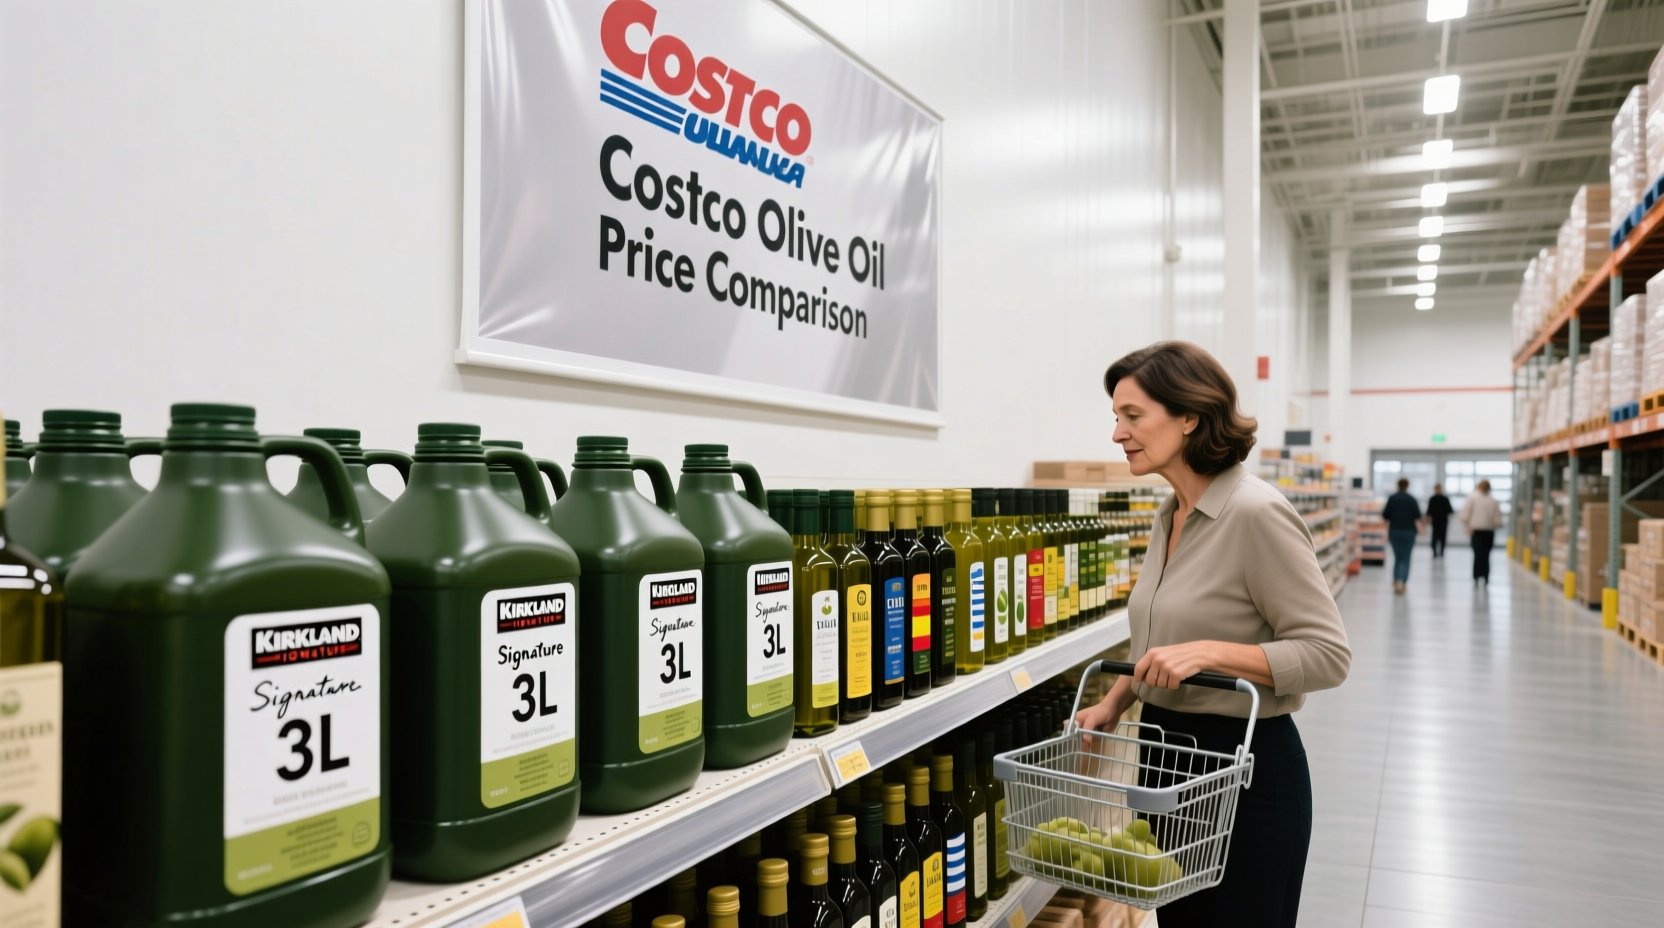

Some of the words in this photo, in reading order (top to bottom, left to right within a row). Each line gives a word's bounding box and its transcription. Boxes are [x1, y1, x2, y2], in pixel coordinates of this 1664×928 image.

[601, 0, 812, 156] COSTCO
[600, 134, 746, 240] Costco
[757, 198, 840, 274] Olive
[848, 235, 885, 290] Oil
[599, 214, 696, 293] Price
[706, 250, 868, 339] Comparison
[500, 598, 565, 620] KIRKLAND
[255, 623, 360, 654] KIRKLAND
[498, 642, 564, 671] Signature
[763, 623, 786, 658] 3L
[660, 641, 692, 684] 3L
[250, 674, 362, 719] Signature
[512, 670, 558, 722] 3L
[276, 713, 350, 781] 3L
